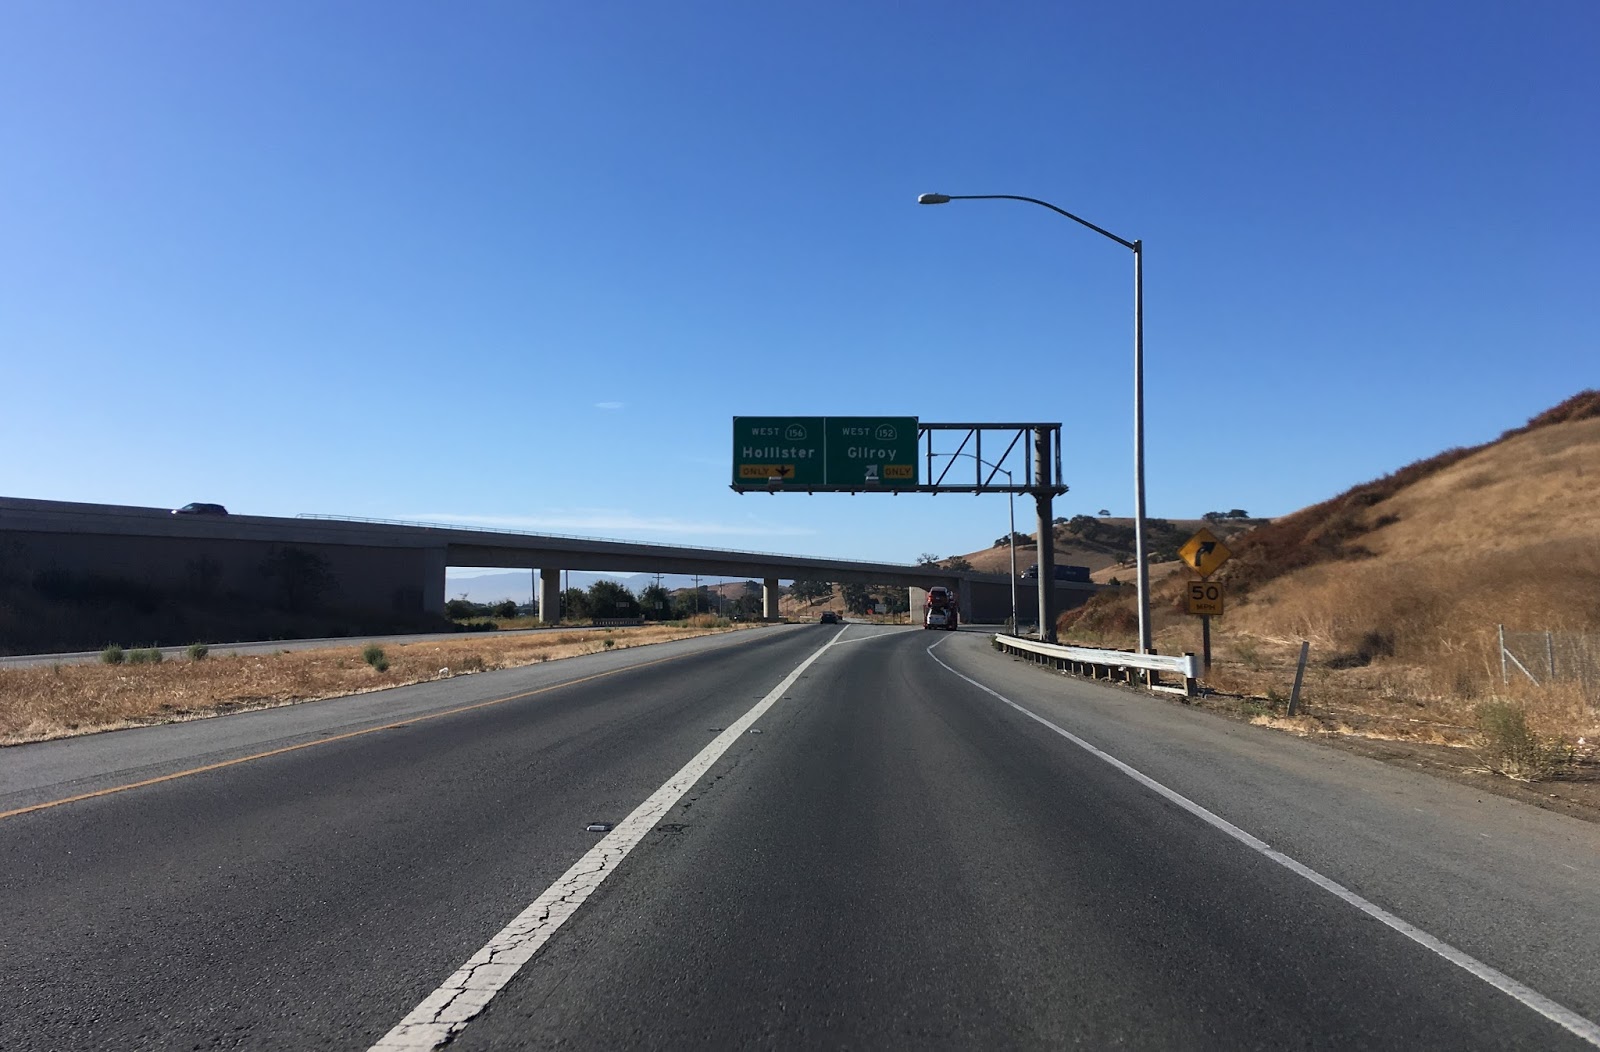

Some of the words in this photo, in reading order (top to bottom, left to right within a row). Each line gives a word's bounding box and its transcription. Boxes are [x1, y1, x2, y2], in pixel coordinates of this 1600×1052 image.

[752, 427, 780, 436] WEST
[789, 429, 803, 437] 156
[842, 427, 870, 436] WEST
[879, 429, 894, 437] 152
[743, 446, 815, 459] Hollister
[848, 447, 897, 461] Gilroy
[885, 468, 911, 476] ONLY
[1192, 586, 1219, 600] 50
